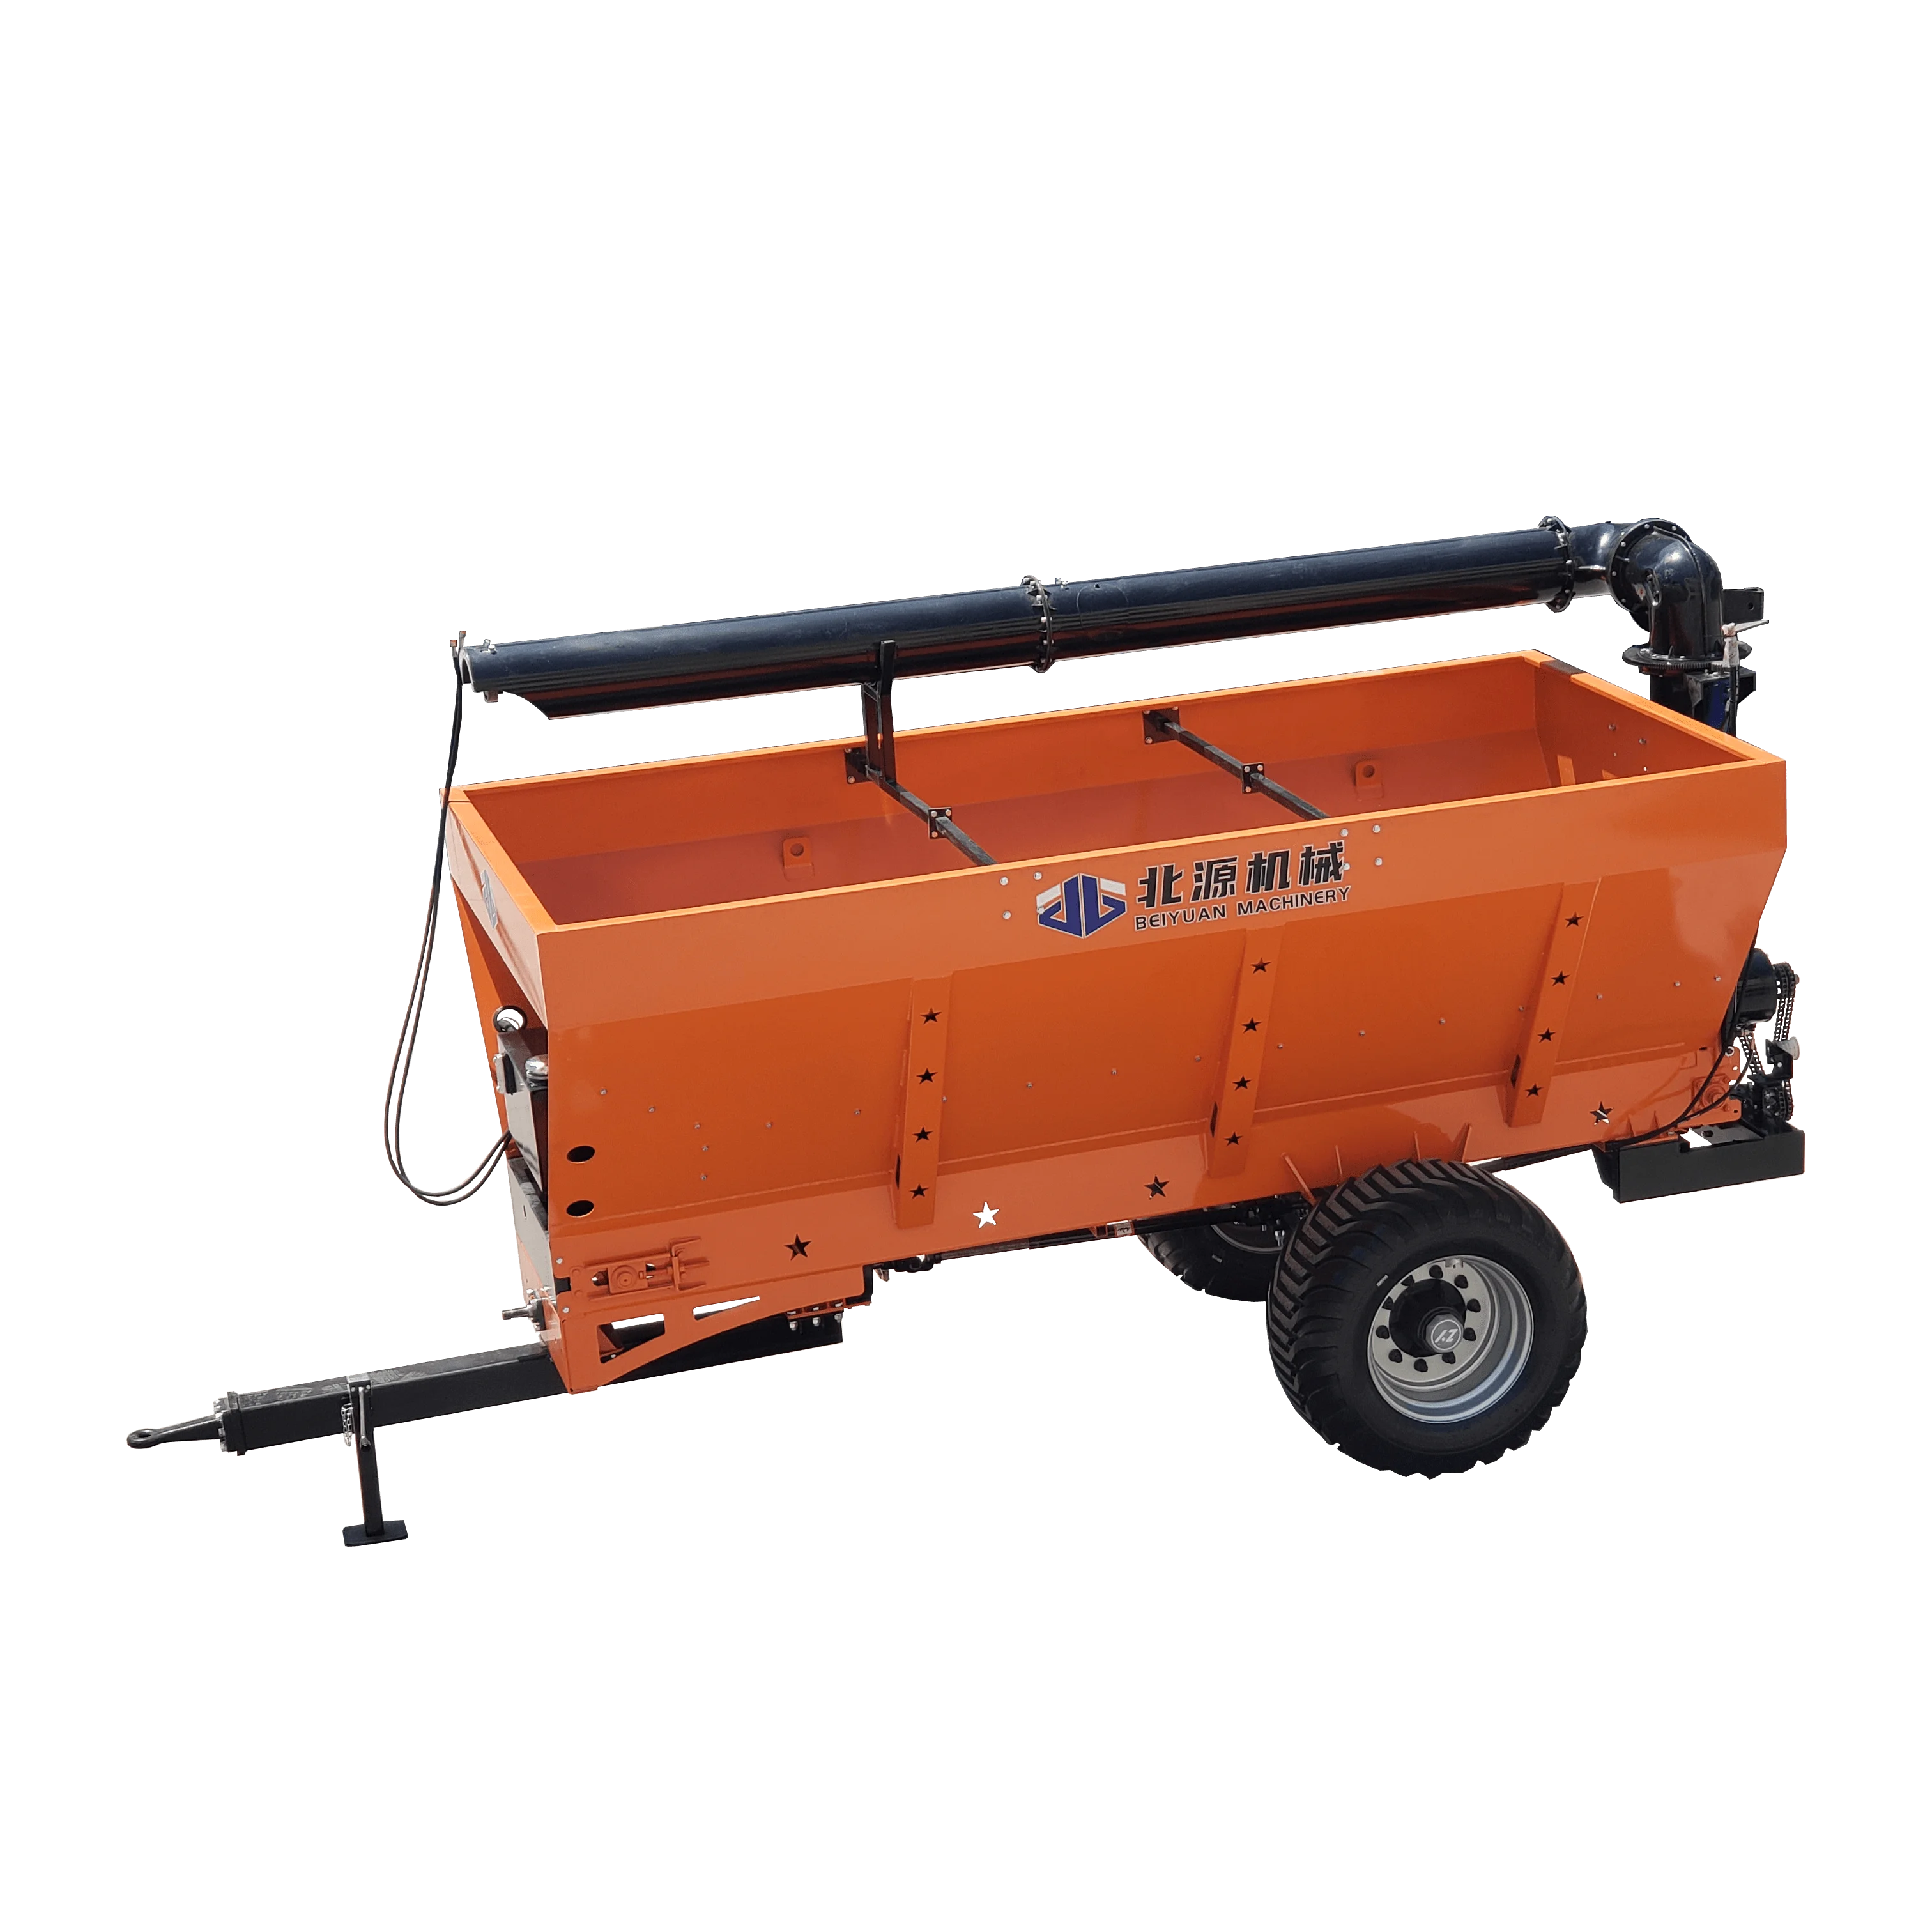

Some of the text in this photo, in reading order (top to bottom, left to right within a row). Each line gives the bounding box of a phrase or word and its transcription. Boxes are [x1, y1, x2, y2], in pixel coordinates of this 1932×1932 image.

[1137, 841, 1344, 908] 北源机械
[1135, 886, 1351, 930] BEIYUAN MACHINERY
